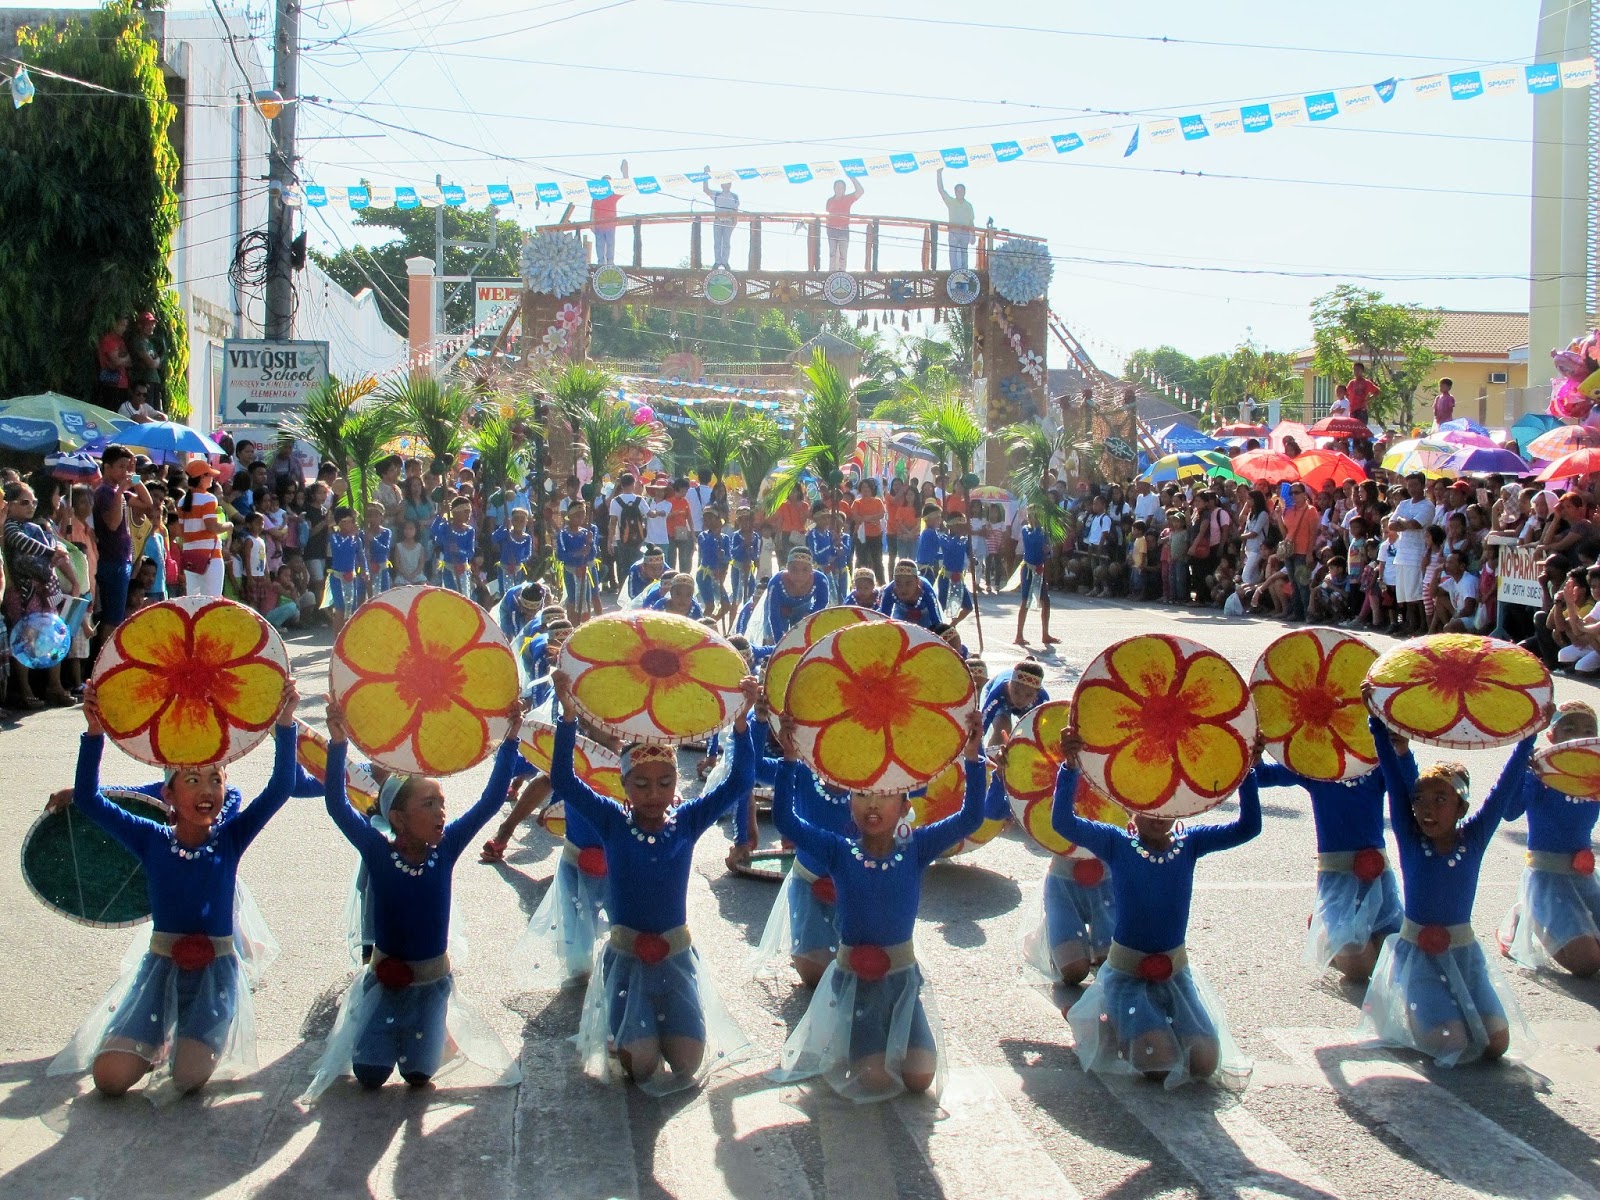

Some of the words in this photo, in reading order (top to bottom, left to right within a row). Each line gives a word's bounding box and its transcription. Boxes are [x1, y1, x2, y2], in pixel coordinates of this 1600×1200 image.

[1563, 70, 1592, 80] SMART
[1487, 79, 1516, 88] SMART
[1528, 75, 1557, 86] SMART
[1415, 81, 1442, 92] SMART
[1452, 82, 1480, 92] SMART
[1345, 96, 1371, 106] SMART
[1308, 103, 1335, 113] SMART
[1275, 110, 1300, 119] SMART
[1214, 120, 1239, 129] SMART
[1244, 115, 1270, 125] SMART
[1151, 128, 1176, 137] SMART
[1056, 138, 1080, 148] SMART
[996, 146, 1019, 156] SMART
[970, 153, 992, 161] SMART
[260, 366, 316, 381] School
[230, 380, 259, 389] NURSERY
[266, 380, 293, 389] KINDER
[250, 390, 298, 398] ELEMENTARY
[0, 423, 51, 438] SMART
[1501, 551, 1512, 577] NO
[1504, 583, 1511, 594] ON
[1512, 584, 1525, 596] BOTH
[1526, 586, 1542, 599] SIDES
